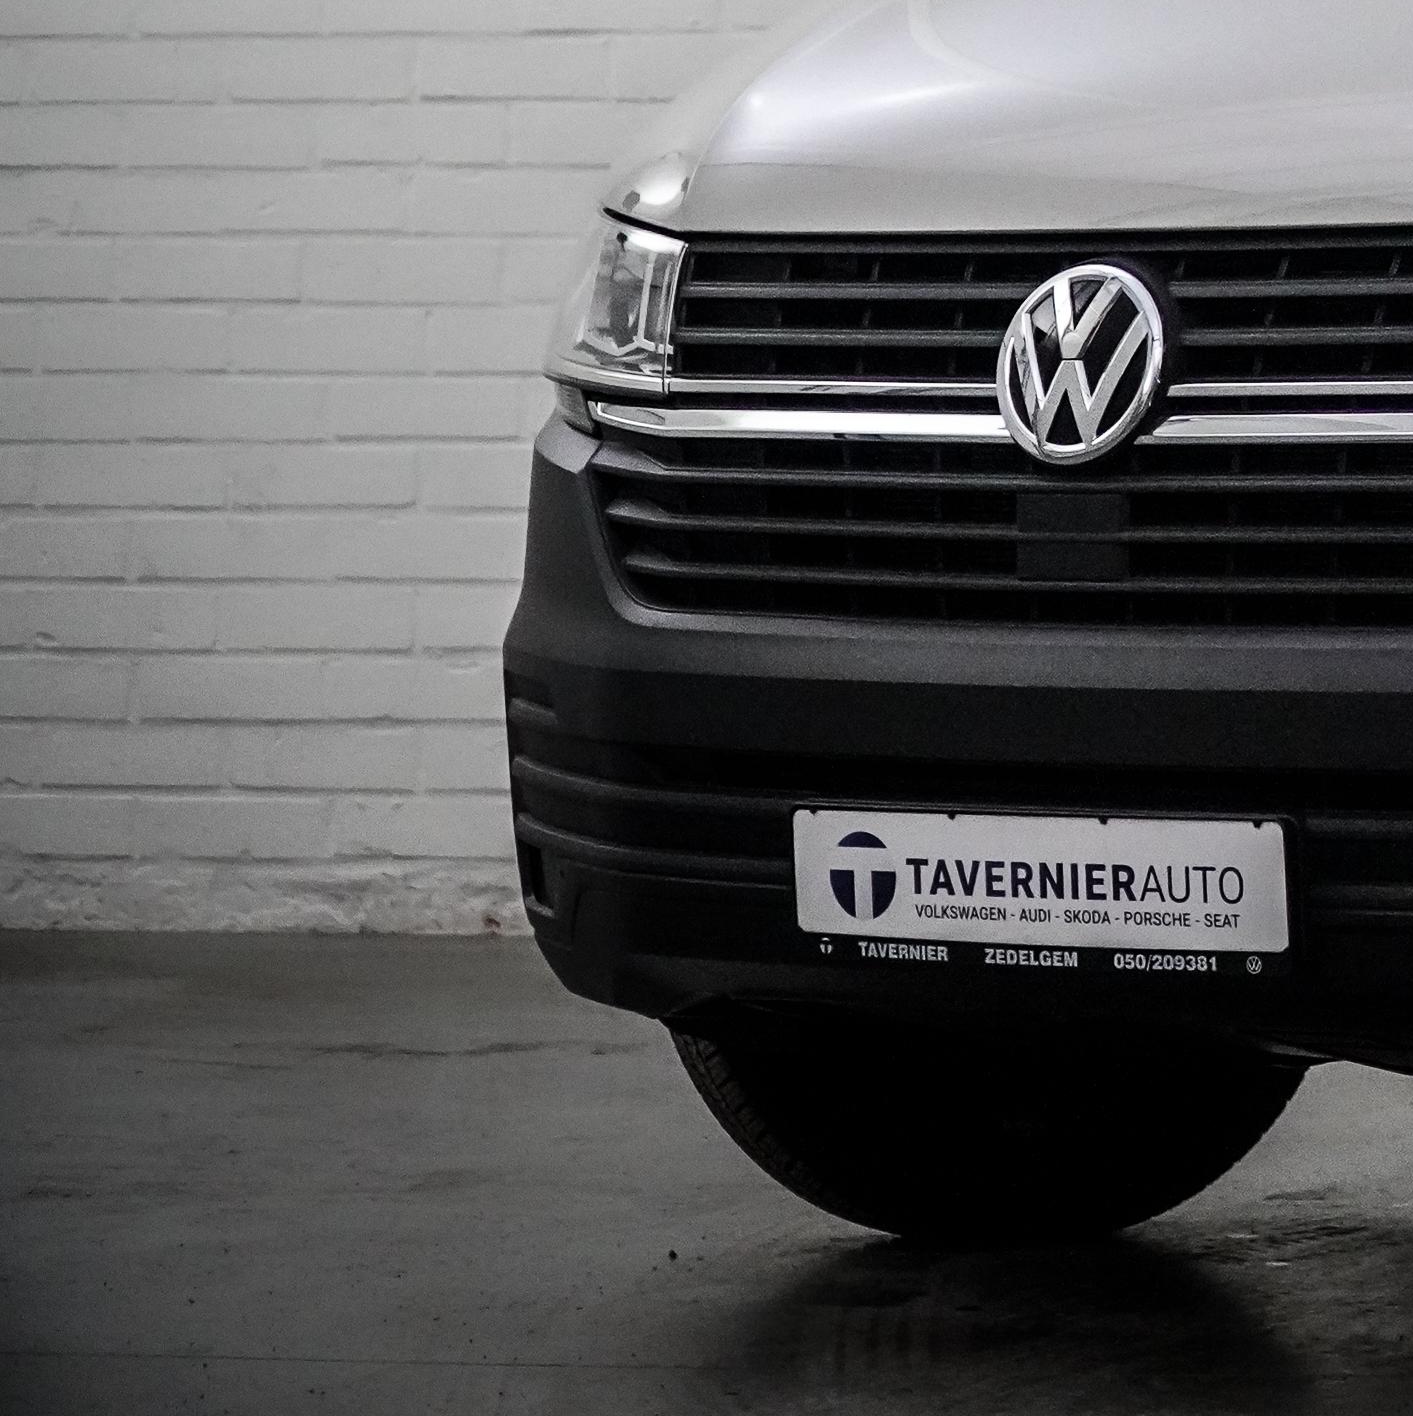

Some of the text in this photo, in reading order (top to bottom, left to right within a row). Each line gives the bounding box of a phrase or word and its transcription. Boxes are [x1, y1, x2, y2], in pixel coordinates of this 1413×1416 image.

[996, 264, 1163, 465] VW
[905, 857, 1244, 905] TAVERNIERAUTO
[914, 903, 1007, 922] VOLKSWAGEN
[1019, 907, 1051, 924] AUDI
[1063, 908, 1111, 925] SKODA
[1123, 911, 1192, 928] PORSCHE
[1203, 913, 1241, 929] SEAT
[857, 940, 1218, 972] TAVERNIER ZEDELGEM 050/209381
